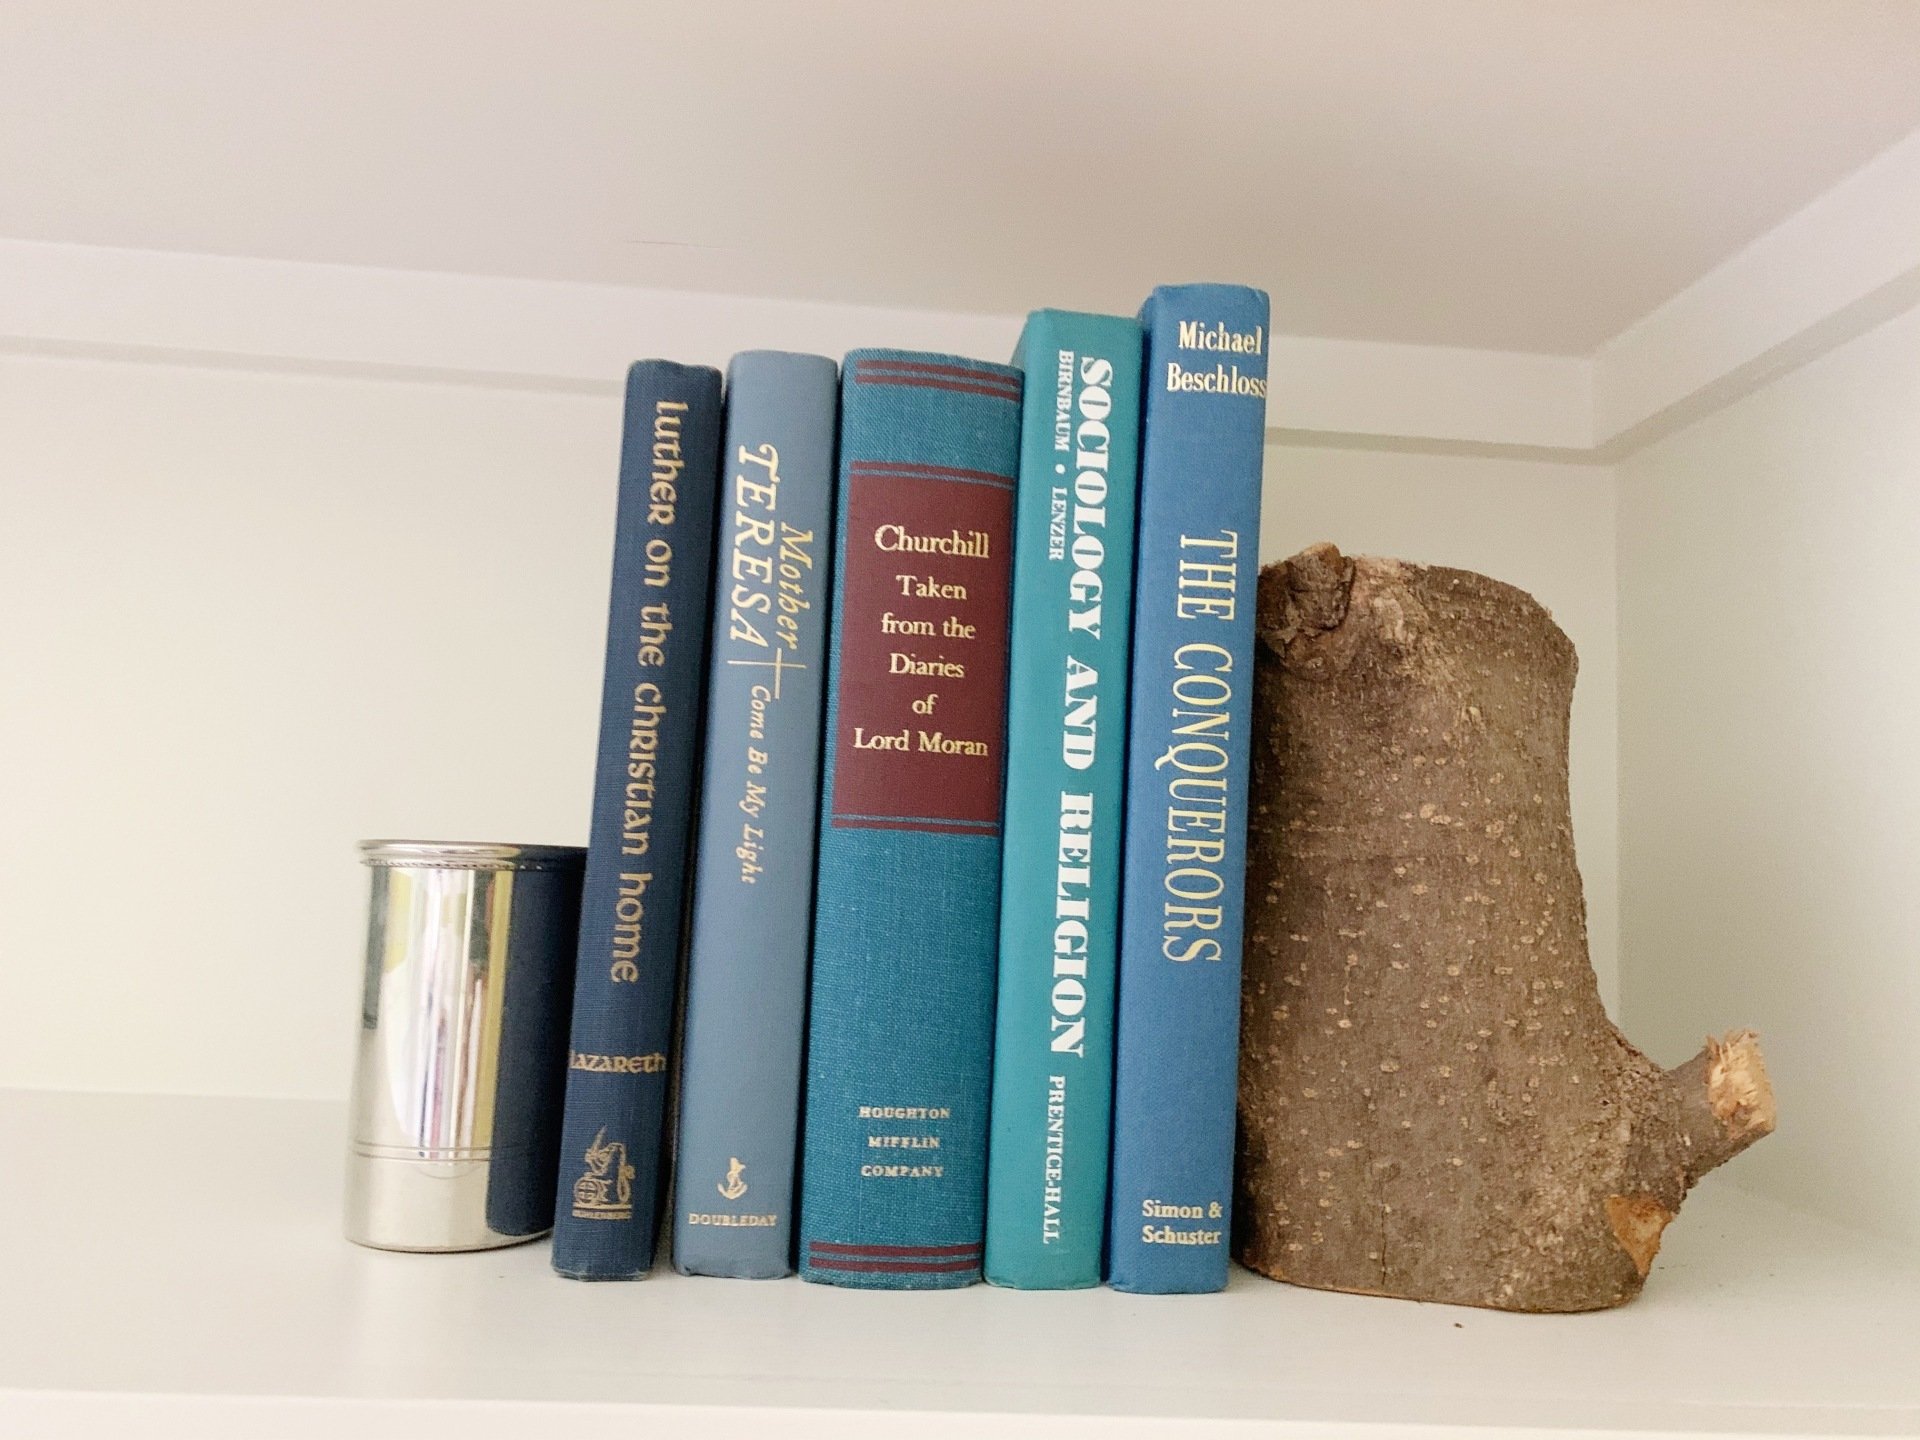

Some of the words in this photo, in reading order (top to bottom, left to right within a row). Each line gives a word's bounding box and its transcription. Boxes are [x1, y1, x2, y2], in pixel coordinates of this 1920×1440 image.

[1179, 320, 1262, 355] Michael
[1054, 349, 1074, 451] BIRNBAUM
[1167, 362, 1266, 400] Beschloss
[1069, 356, 1113, 640] SOCIOLOGY
[875, 523, 989, 559] Churchill
[1048, 486, 1067, 560] LENZER
[643, 538, 671, 587] on
[730, 443, 779, 648] TERESA
[776, 521, 813, 650] Mother
[896, 574, 966, 600] Taken
[1177, 529, 1237, 621] THE
[638, 602, 671, 667] the
[881, 611, 934, 636] from
[943, 616, 975, 640] the
[889, 652, 964, 678] Diaries
[749, 684, 771, 739] Come
[911, 693, 938, 715] of
[1063, 655, 1098, 770] AND
[747, 746, 767, 773] Be
[854, 726, 909, 752] Lord
[918, 730, 987, 756] Moran
[738, 780, 766, 818] My
[1155, 643, 1233, 962] CONQUERORS
[735, 823, 763, 884] Light
[611, 872, 652, 982] home
[1051, 790, 1092, 1058] RELIGION
[858, 1105, 950, 1120] HOUGHTON
[868, 1136, 939, 1149] MIFFLIN
[1042, 1075, 1065, 1244] PRENTICE-HALL
[861, 1164, 943, 1178] COMPANY
[689, 1212, 776, 1226] DOUBLEDAY
[1142, 1199, 1203, 1219] Simon
[1208, 1201, 1221, 1218] &
[1142, 1225, 1221, 1245] Schuster
